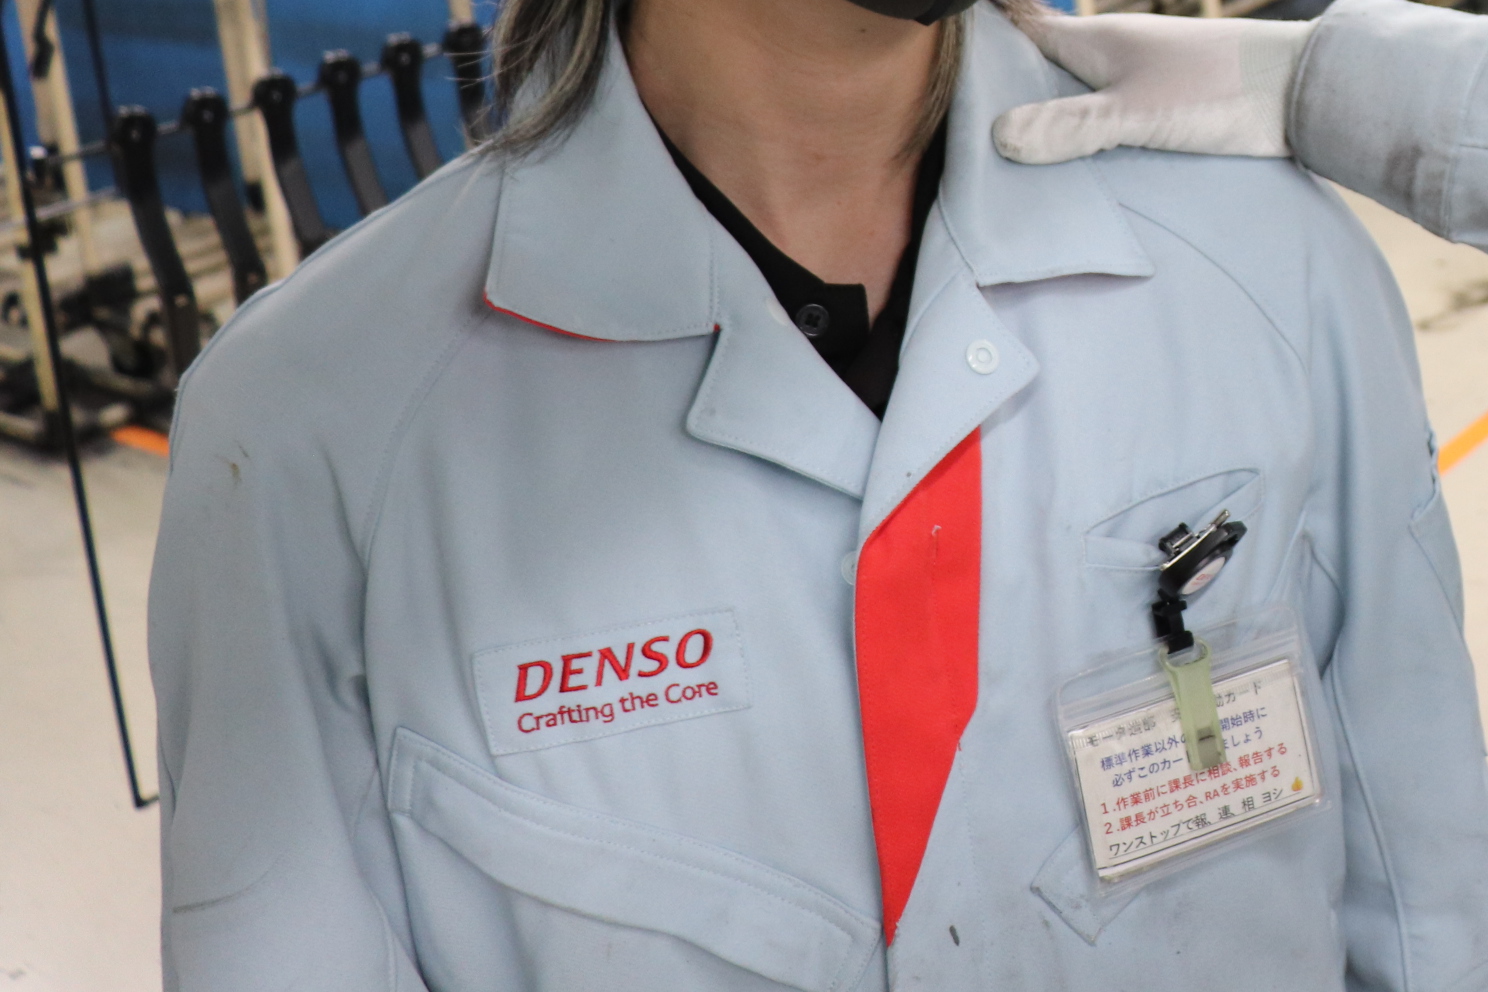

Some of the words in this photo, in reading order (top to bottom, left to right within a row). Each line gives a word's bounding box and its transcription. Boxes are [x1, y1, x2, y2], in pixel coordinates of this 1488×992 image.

[514, 628, 714, 703] DENSO
[516, 701, 616, 734] Crafting
[618, 692, 660, 714] the
[664, 680, 719, 705] Core
